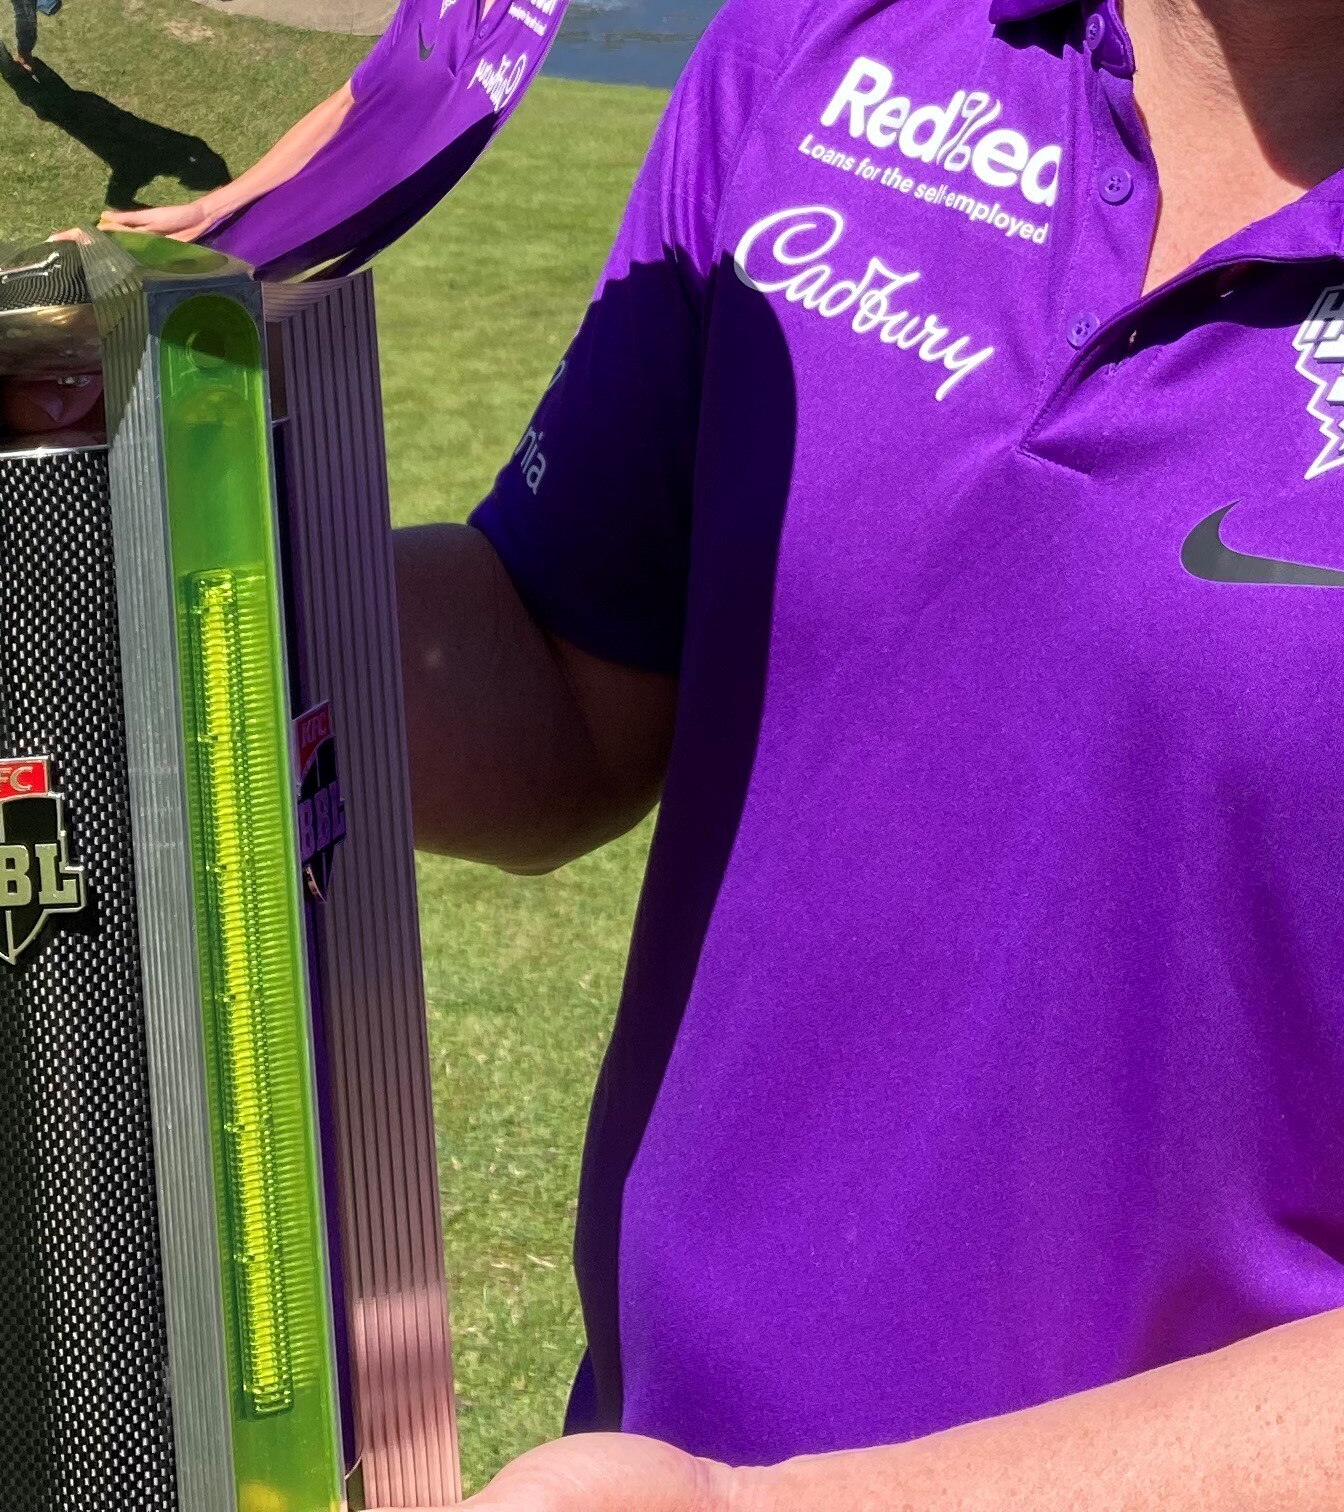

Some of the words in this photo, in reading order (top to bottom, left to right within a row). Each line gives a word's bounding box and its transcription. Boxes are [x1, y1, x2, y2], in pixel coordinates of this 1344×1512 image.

[797, 133, 855, 172] Loans
[855, 157, 882, 181] for
[880, 167, 914, 194] the
[733, 204, 995, 402] Cadbury
